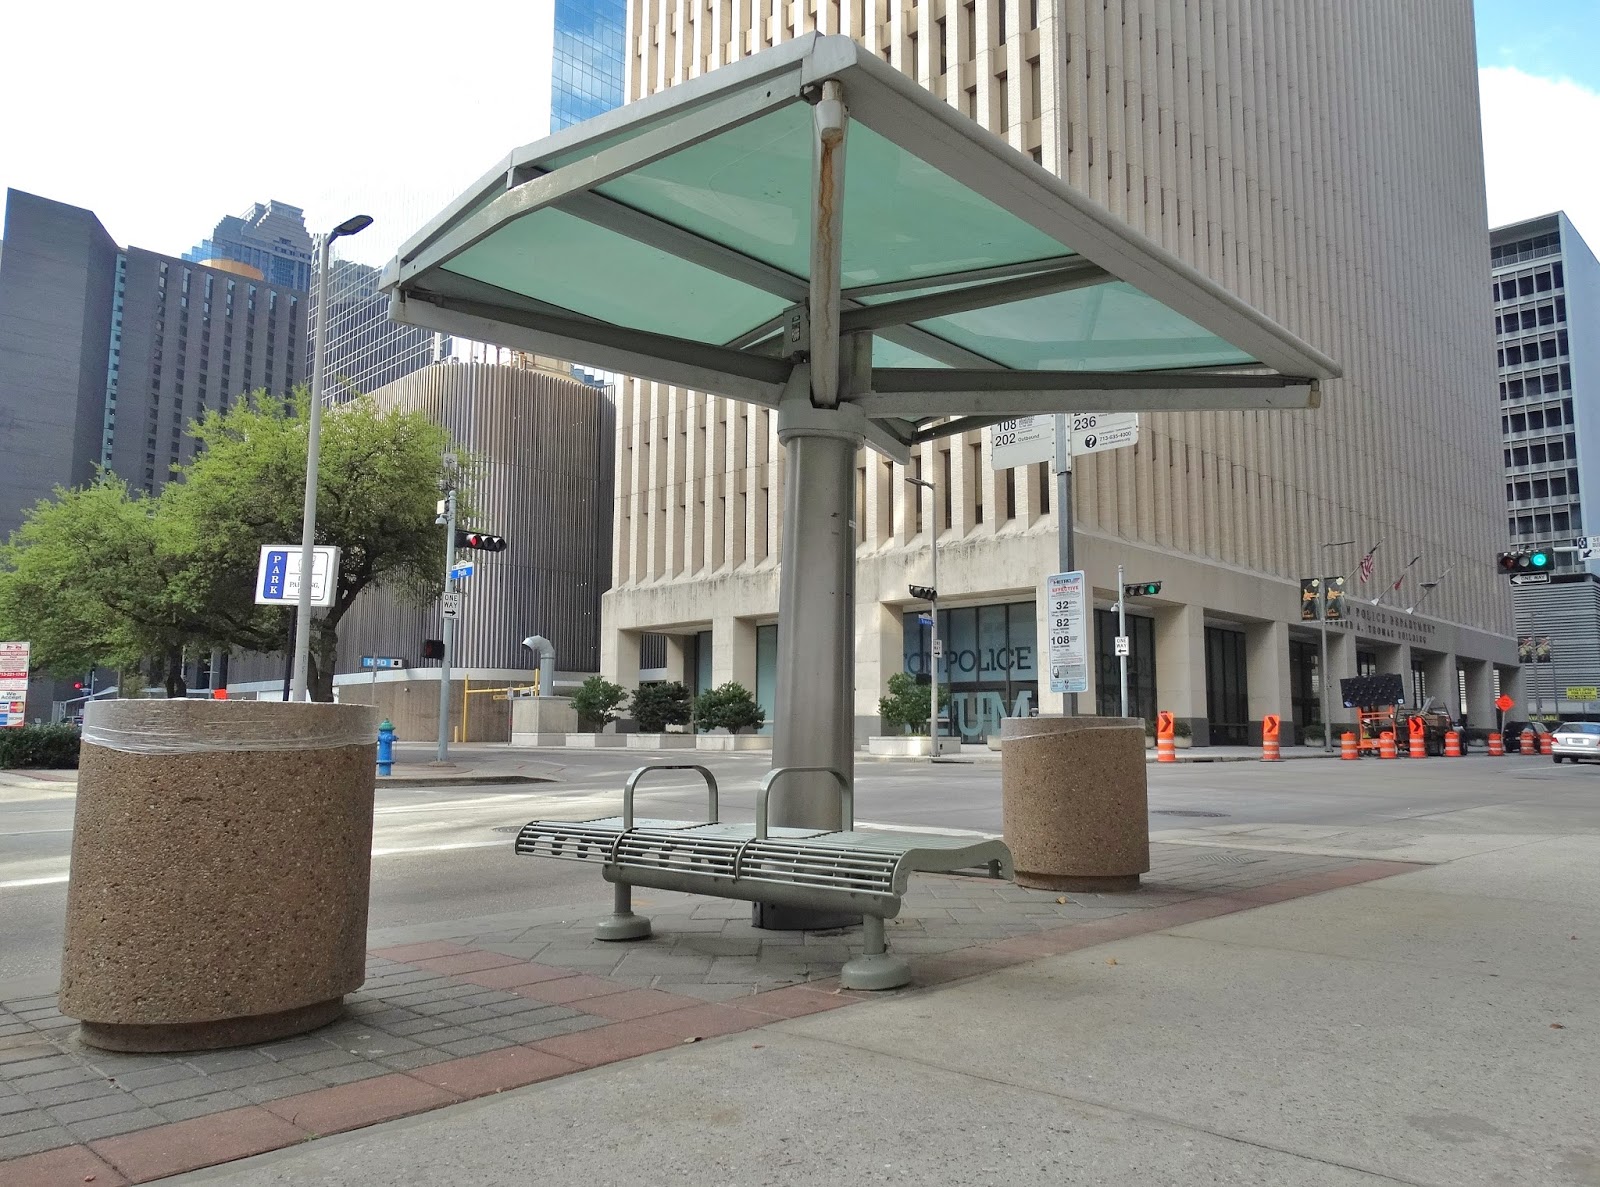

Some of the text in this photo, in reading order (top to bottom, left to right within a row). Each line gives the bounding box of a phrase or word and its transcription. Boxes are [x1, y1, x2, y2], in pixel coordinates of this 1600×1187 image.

[998, 420, 1016, 432] 108
[1074, 416, 1096, 430] 236
[995, 433, 1016, 447] 202
[269, 555, 282, 594] PARK
[444, 594, 458, 602] ONE
[1056, 600, 1069, 610] 32
[1056, 618, 1070, 627] 82
[1356, 607, 1385, 624] POLICE
[1390, 615, 1435, 635] DEPARTMENT
[1051, 635, 1070, 645] 108
[944, 646, 1032, 673] POLICE
